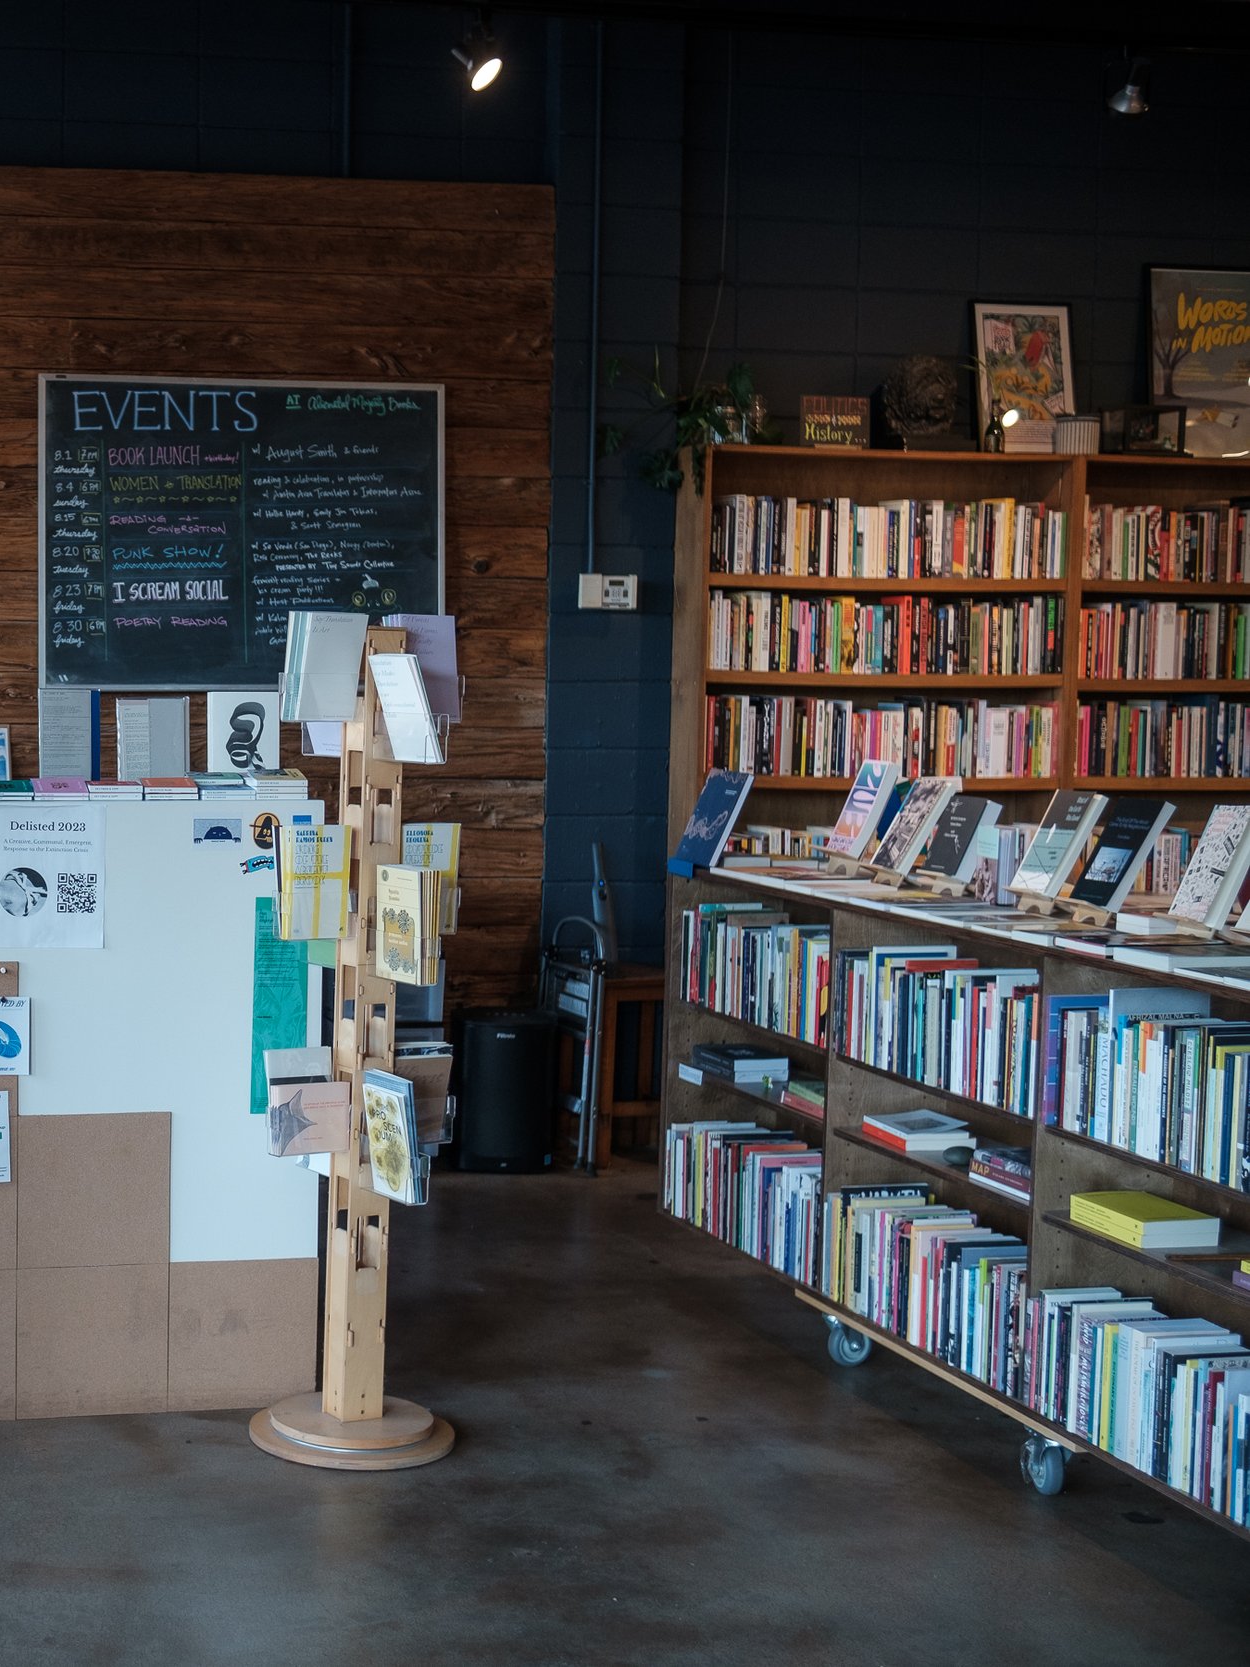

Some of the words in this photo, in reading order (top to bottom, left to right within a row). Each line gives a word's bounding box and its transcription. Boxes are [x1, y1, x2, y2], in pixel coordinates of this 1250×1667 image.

[1177, 292, 1247, 330] WORDS
[1172, 337, 1188, 351] IN
[286, 394, 301, 406] AT
[72, 390, 257, 432] EVENTS
[54, 450, 73, 461] 8.1
[108, 448, 146, 466] BOOK
[150, 445, 200, 466] LAUNCH
[266, 445, 304, 463] August
[307, 444, 338, 459] Smith
[55, 482, 74, 494] 8.4
[110, 476, 160, 491] WOMEN
[177, 474, 243, 491] TRANSLATION
[253, 475, 282, 489] reading
[55, 513, 76, 522] 8.15
[52, 546, 81, 558] 8.20
[112, 547, 155, 560] PUNK
[52, 583, 81, 599] 8.23
[112, 581, 127, 604] I
[129, 580, 182, 602] SCREAM
[185, 578, 229, 602] SOCIAL
[52, 619, 84, 634] 8.30
[113, 615, 163, 630] POETRY
[170, 615, 229, 629] READING
[10, 821, 55, 834] Delisted
[58, 823, 87, 834] 2023
[16, 1000, 27, 1008] BY
[1127, 1013, 1157, 1022] AFRIZAL
[1158, 1013, 1184, 1021] MALNA
[1099, 1037, 1110, 1109] MACHADO
[382, 1120, 403, 1136] SCEN
[971, 1161, 990, 1176] MAP
